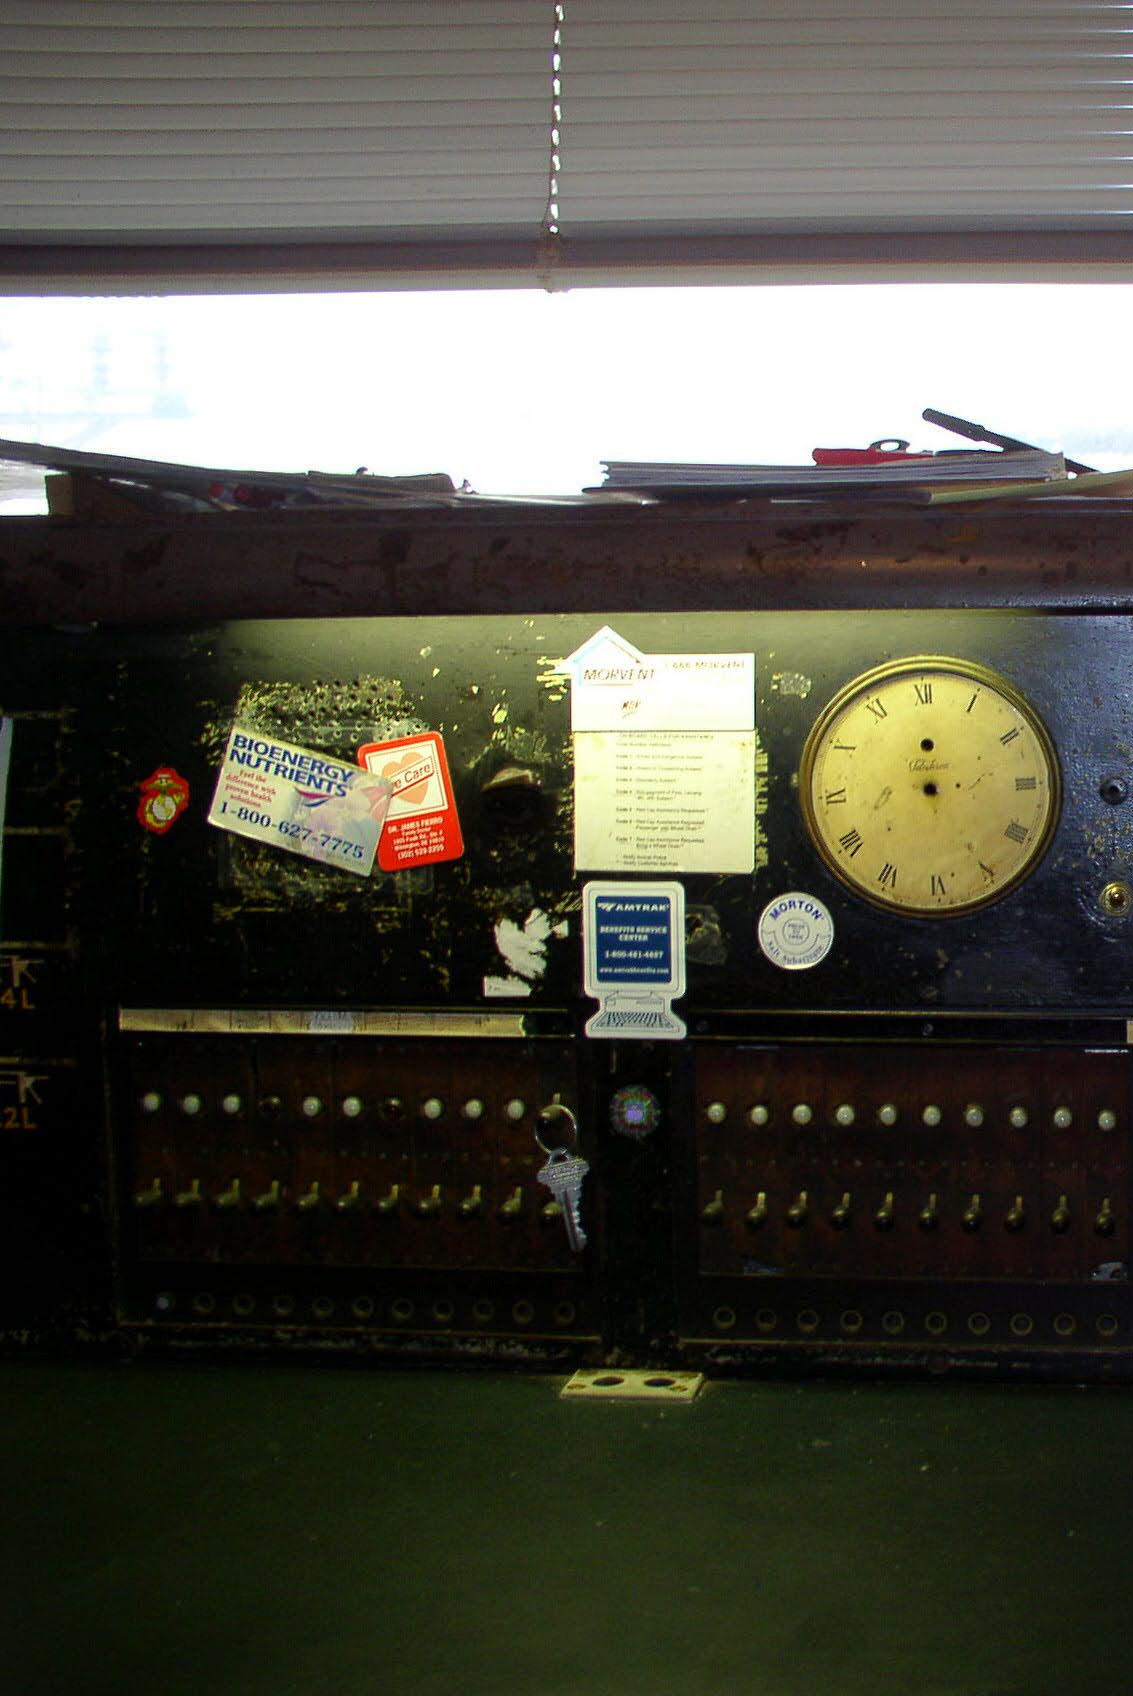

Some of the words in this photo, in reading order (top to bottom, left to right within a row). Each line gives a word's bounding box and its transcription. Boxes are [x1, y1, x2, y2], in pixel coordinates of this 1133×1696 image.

[583, 668, 655, 681] MORVENT
[914, 684, 933, 706] XII
[233, 734, 355, 782] BIOENERGY
[228, 748, 348, 798] NUTRIENTS
[404, 762, 432, 785] Care
[219, 801, 366, 860] 1-800-627-7775
[616, 903, 670, 912] AMTRAK
[769, 899, 823, 920] MORTON
